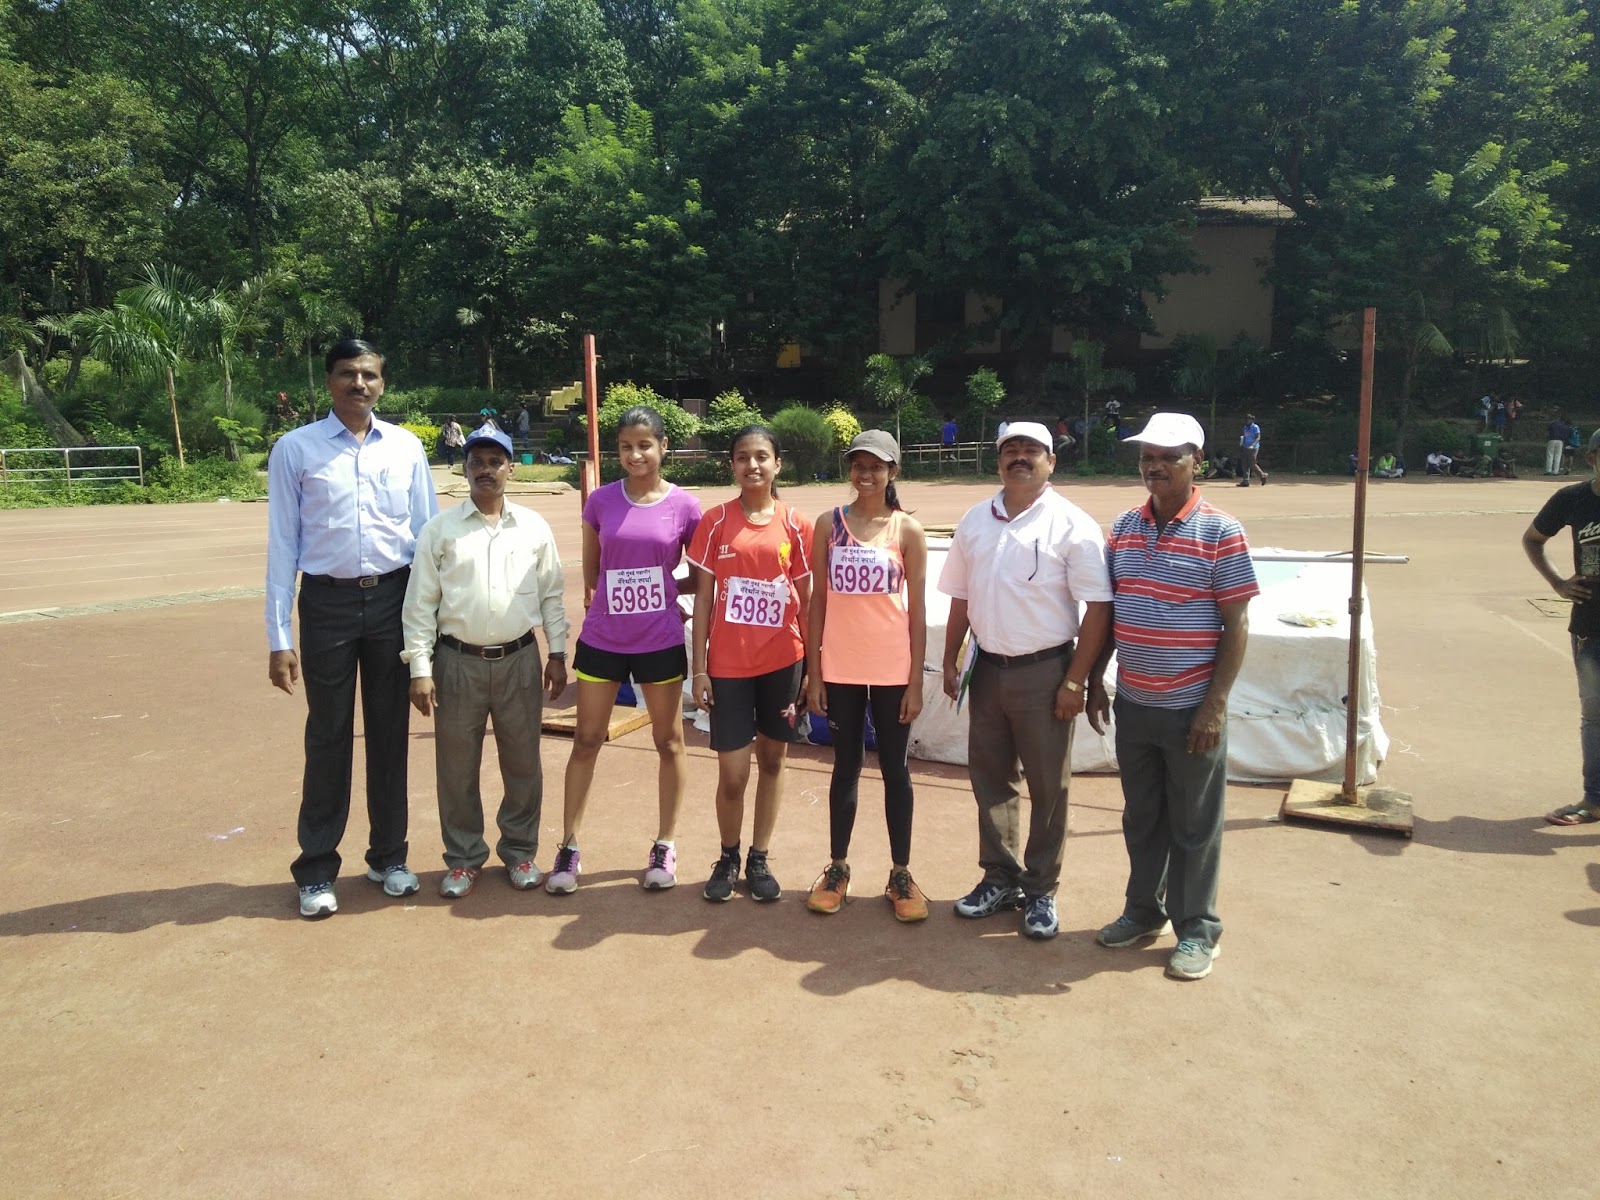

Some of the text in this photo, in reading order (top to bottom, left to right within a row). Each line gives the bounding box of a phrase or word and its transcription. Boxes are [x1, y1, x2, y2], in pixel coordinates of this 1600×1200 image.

[835, 565, 884, 592] 5982
[612, 584, 662, 612] 5985
[730, 595, 781, 625] 5983
